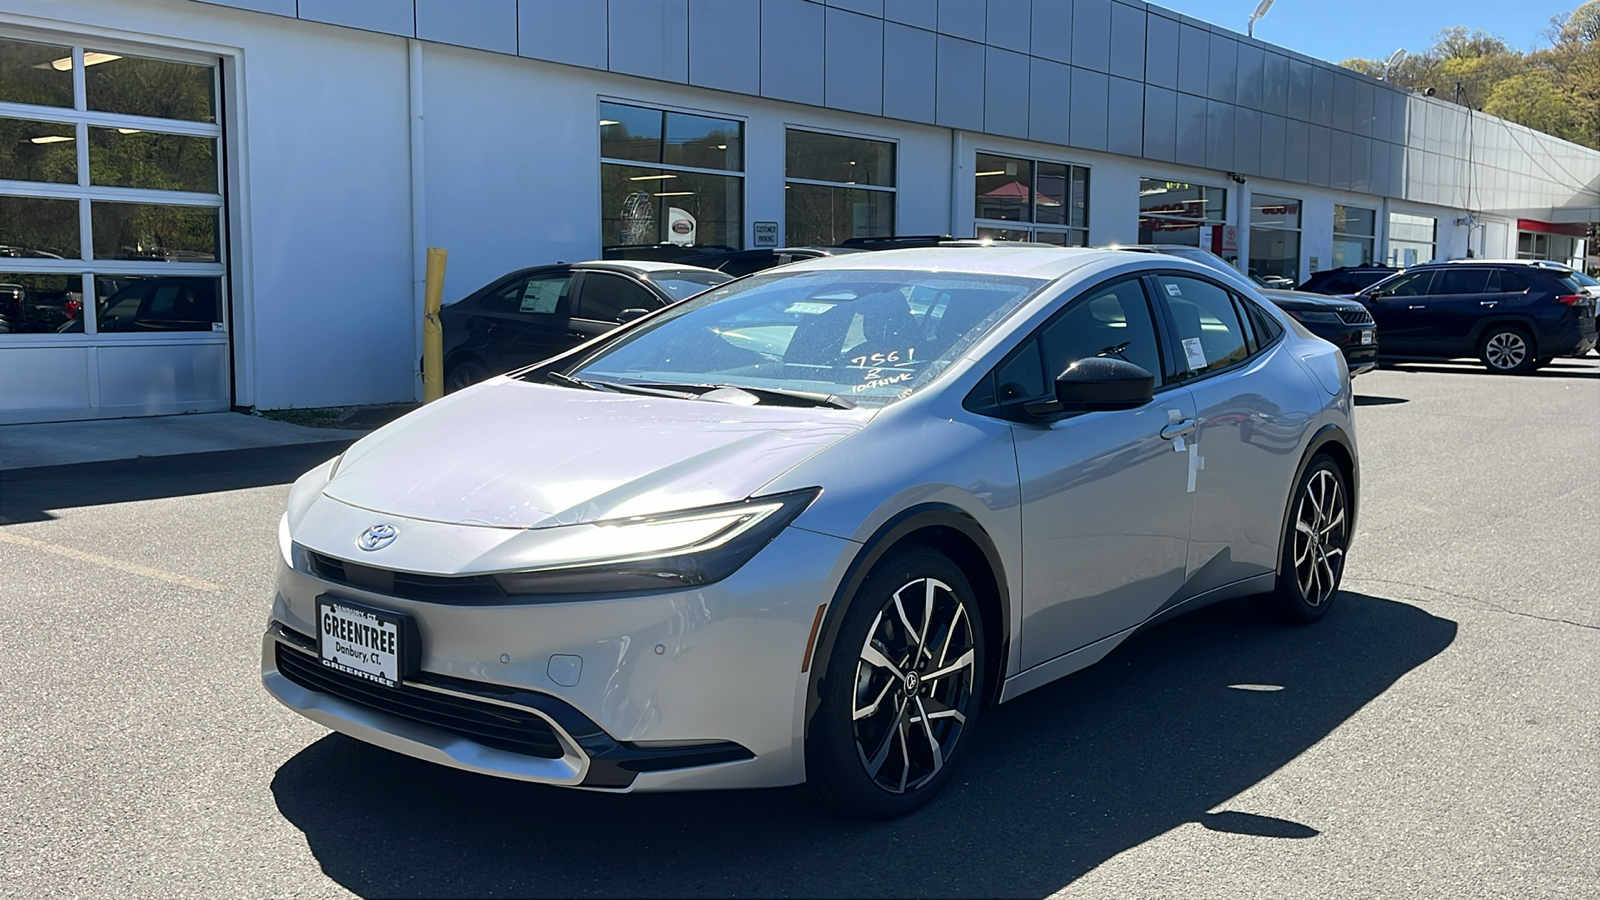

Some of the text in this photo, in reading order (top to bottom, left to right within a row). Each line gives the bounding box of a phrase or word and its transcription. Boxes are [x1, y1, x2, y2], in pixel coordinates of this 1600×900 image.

[756, 225, 776, 233] CUSTOMER
[758, 235, 775, 243] PARKING
[323, 613, 395, 655] GREENTREE
[336, 641, 382, 666] Danbury, CT.
[322, 659, 394, 688] GREENTREE
